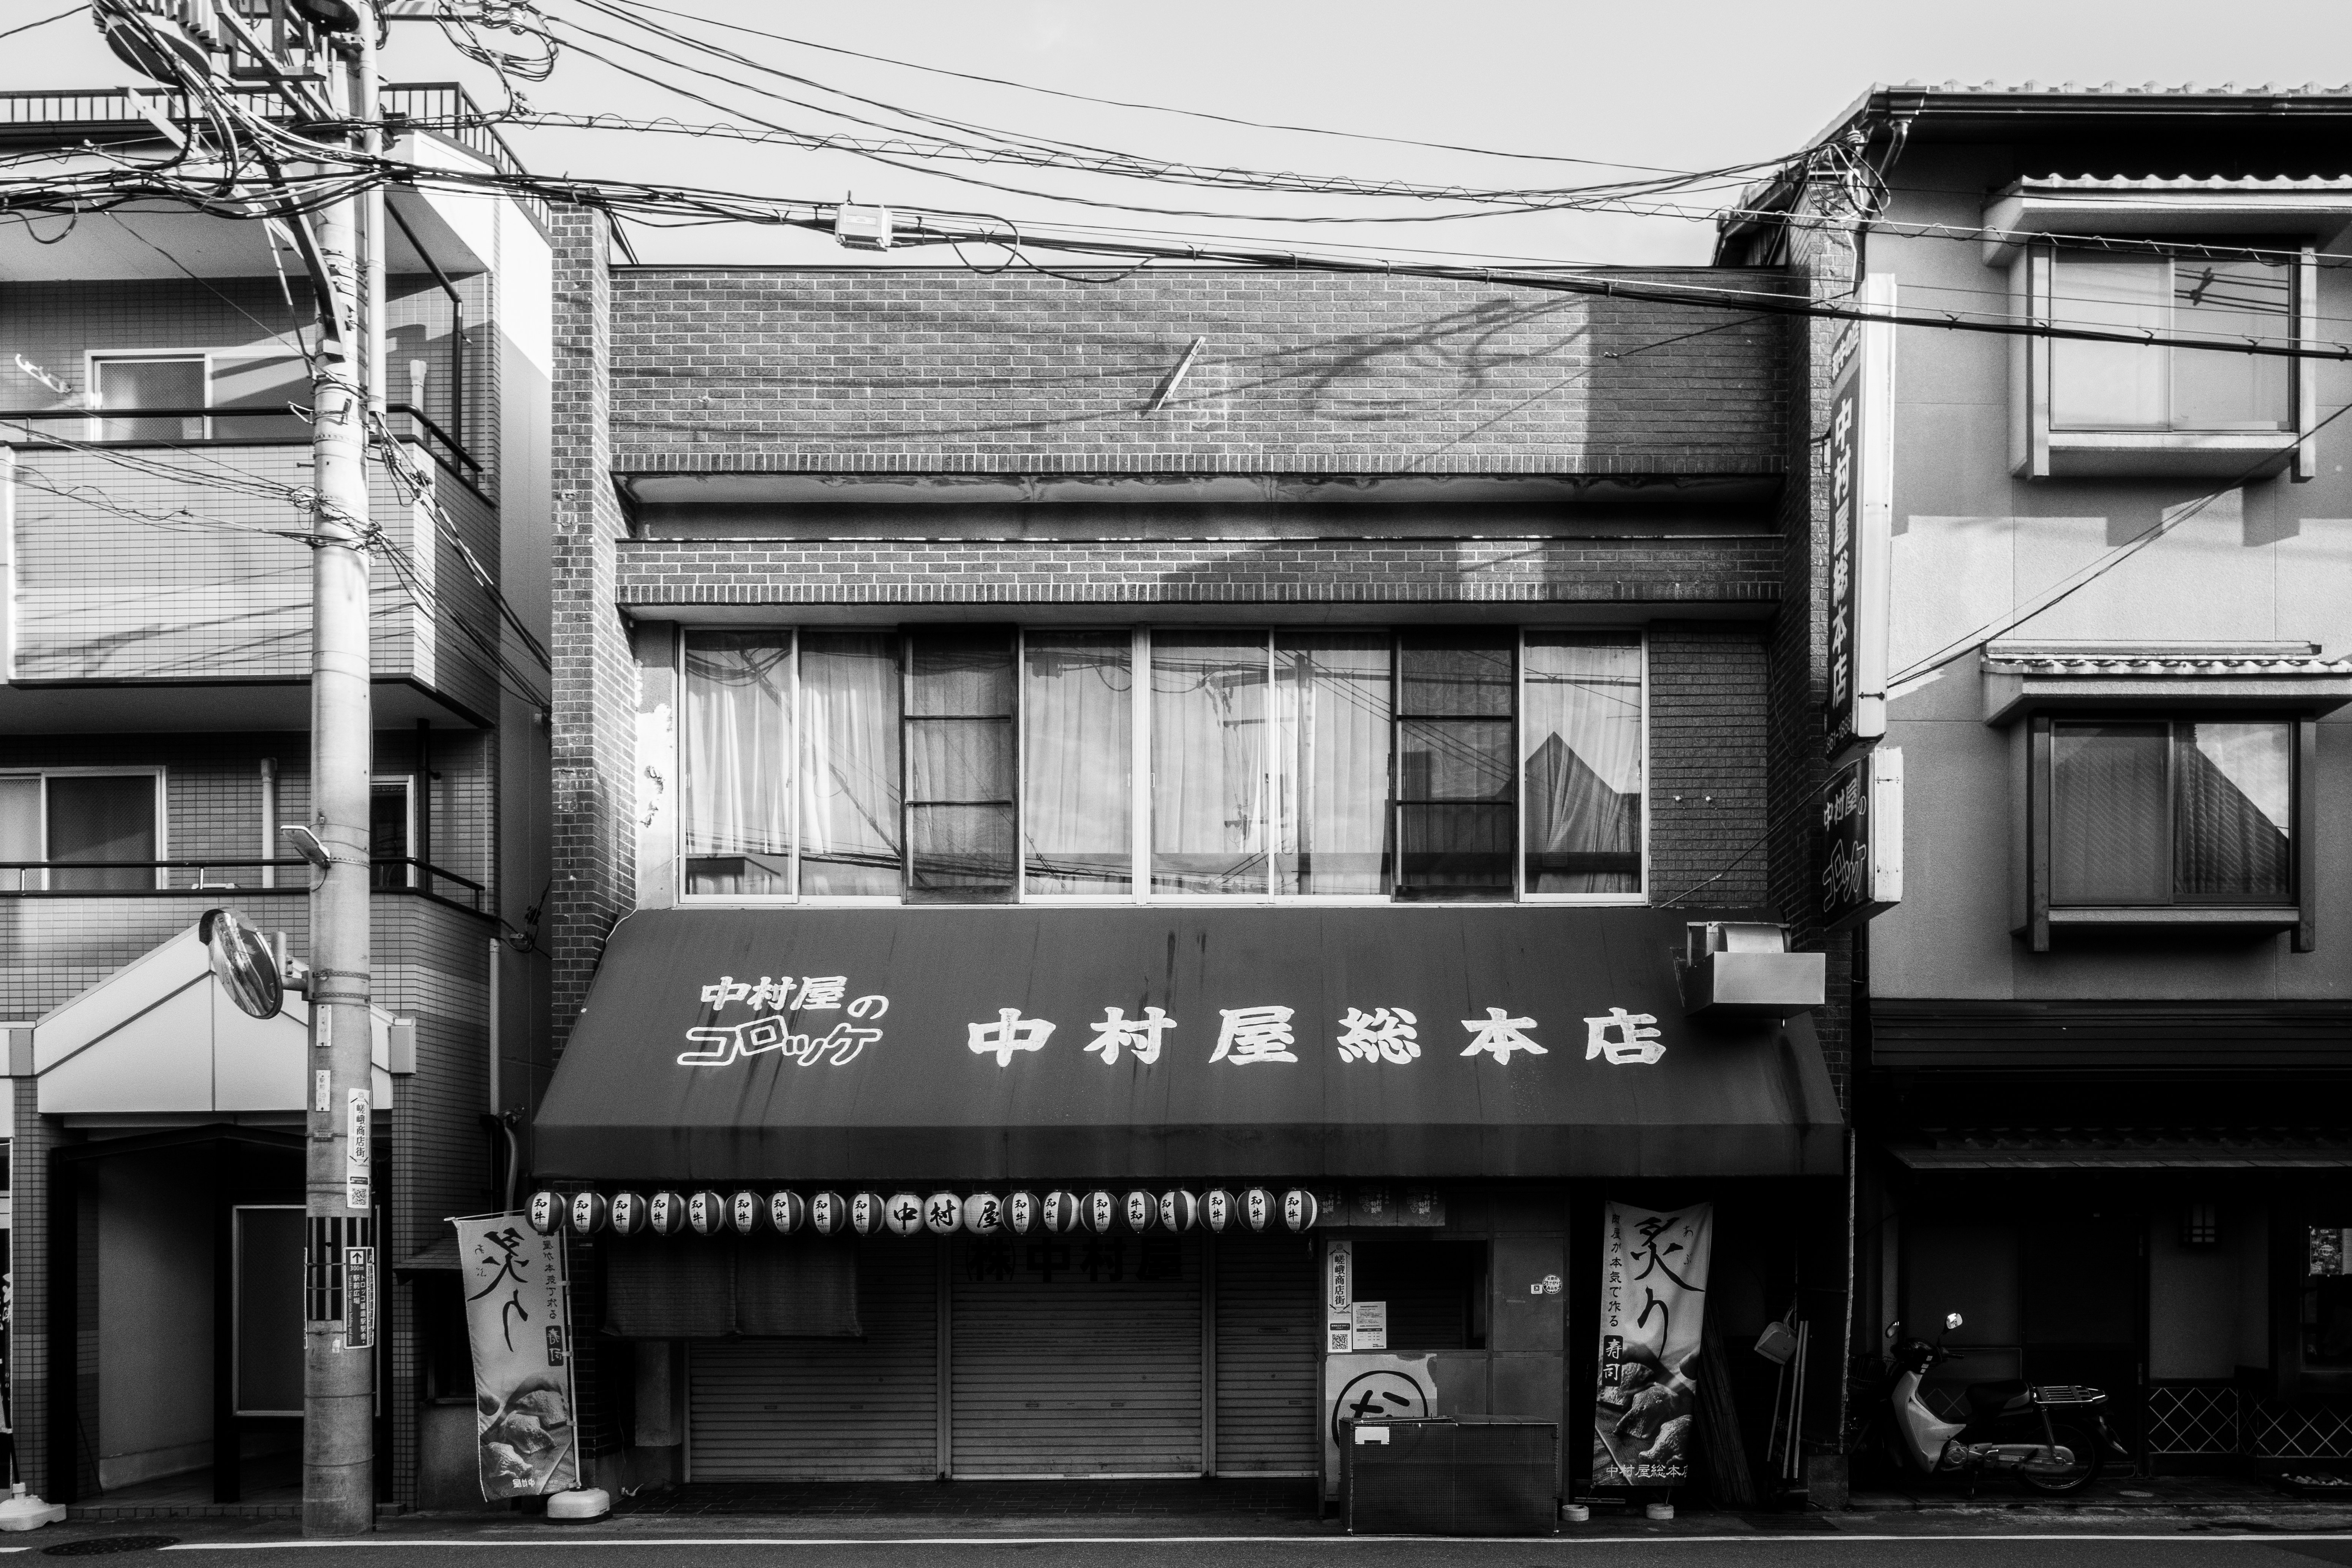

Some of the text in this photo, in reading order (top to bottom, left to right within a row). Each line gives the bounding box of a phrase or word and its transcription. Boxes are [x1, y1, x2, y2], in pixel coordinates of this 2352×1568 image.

[1833, 397, 1852, 710] 中村屋総本店
[1824, 778, 1867, 832] 中村屋の
[1823, 838, 1867, 912] コロッケ
[700, 976, 889, 1020] 中村屋の
[677, 1015, 883, 1067] コロッケ
[968, 1005, 1666, 1067] 中村屋総本店
[356, 1103, 365, 1157] 嵯峨商店街
[534, 1198, 547, 1223] 和牛
[576, 1200, 588, 1224] 和牛
[615, 1200, 628, 1224] 和牛
[654, 1199, 666, 1223] 和牛
[692, 1200, 703, 1224] 和牛
[737, 1199, 750, 1223] 和牛
[774, 1199, 786, 1223] 和牛
[816, 1200, 828, 1224] 和牛
[856, 1200, 867, 1224] 和牛
[894, 1200, 1001, 1231] 中村屋
[1015, 1199, 1027, 1223] 和牛
[1046, 1198, 1057, 1222] 和牛
[1096, 1199, 1108, 1223] 和牛
[1162, 1199, 1173, 1223] 和牛
[1211, 1197, 1223, 1221] 和牛
[1250, 1196, 1263, 1220] 和牛
[1287, 1197, 1299, 1221] 和牛
[1683, 1225, 1694, 1265] あぶ
[1334, 1254, 1345, 1306] 嵯峨商店街
[1608, 1213, 1622, 1327] 肉屋が本気で作る
[1630, 1217, 1706, 1359] 炙り
[1603, 1338, 1622, 1381] 寿司
